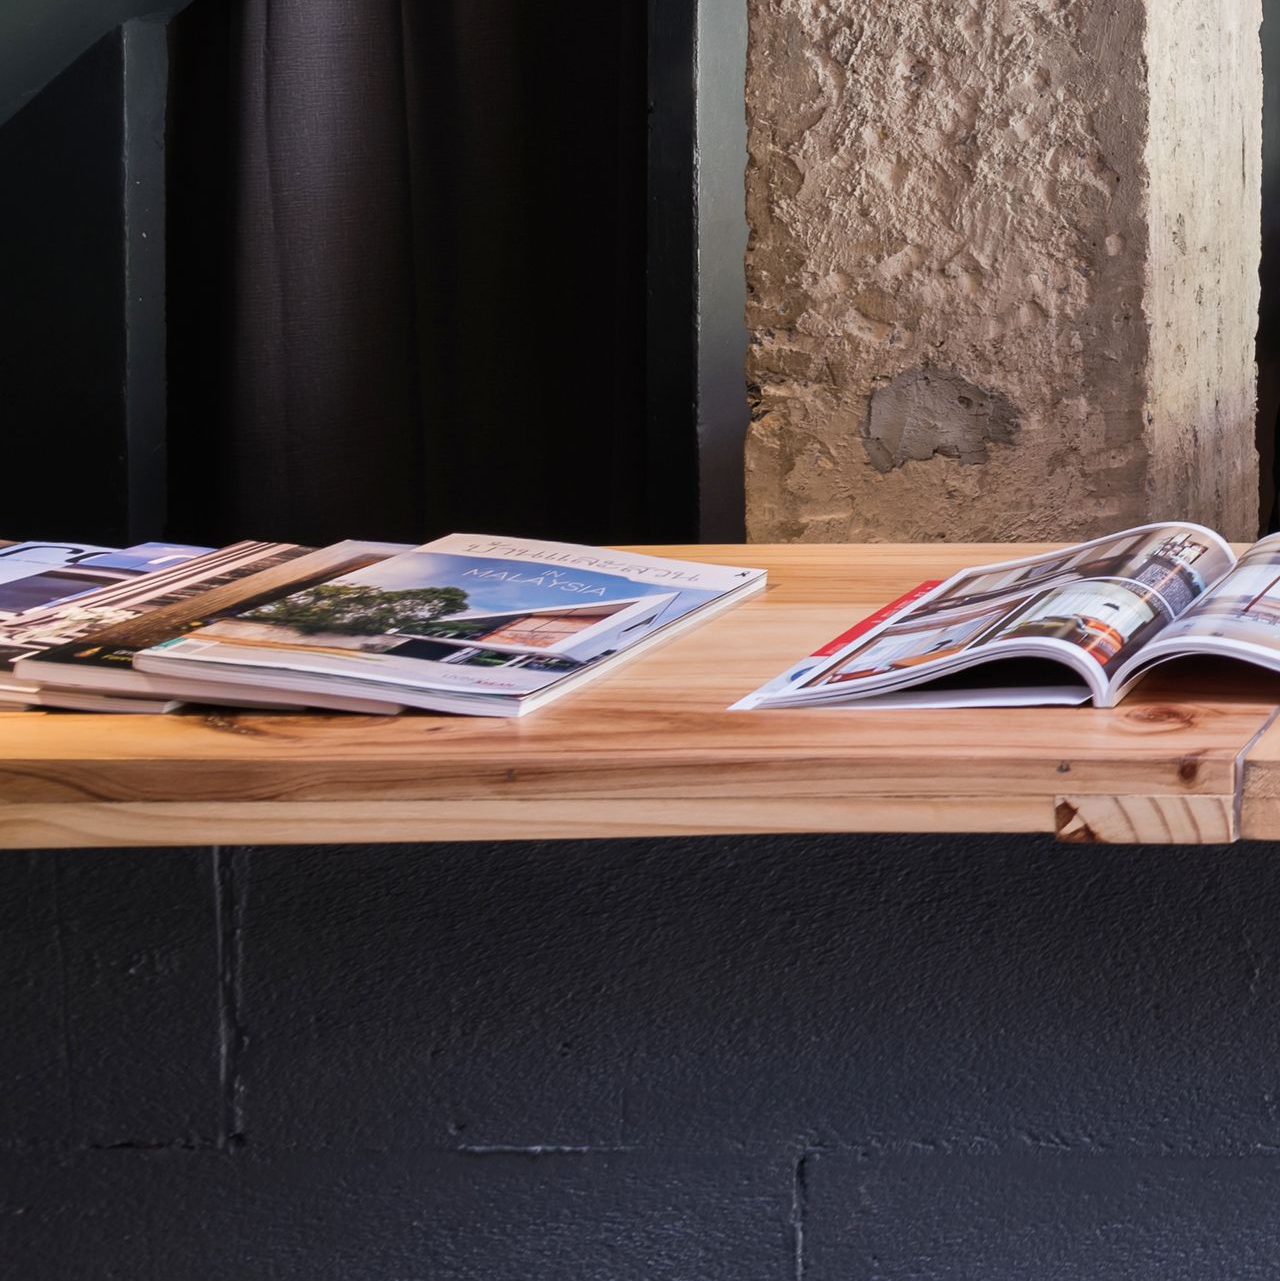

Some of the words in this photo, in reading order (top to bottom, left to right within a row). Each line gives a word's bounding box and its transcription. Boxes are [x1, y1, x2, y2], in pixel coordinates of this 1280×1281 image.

[462, 541, 700, 582] บ้านและสวน
[541, 569, 566, 578] IN
[462, 568, 607, 597] MALAYSIA
